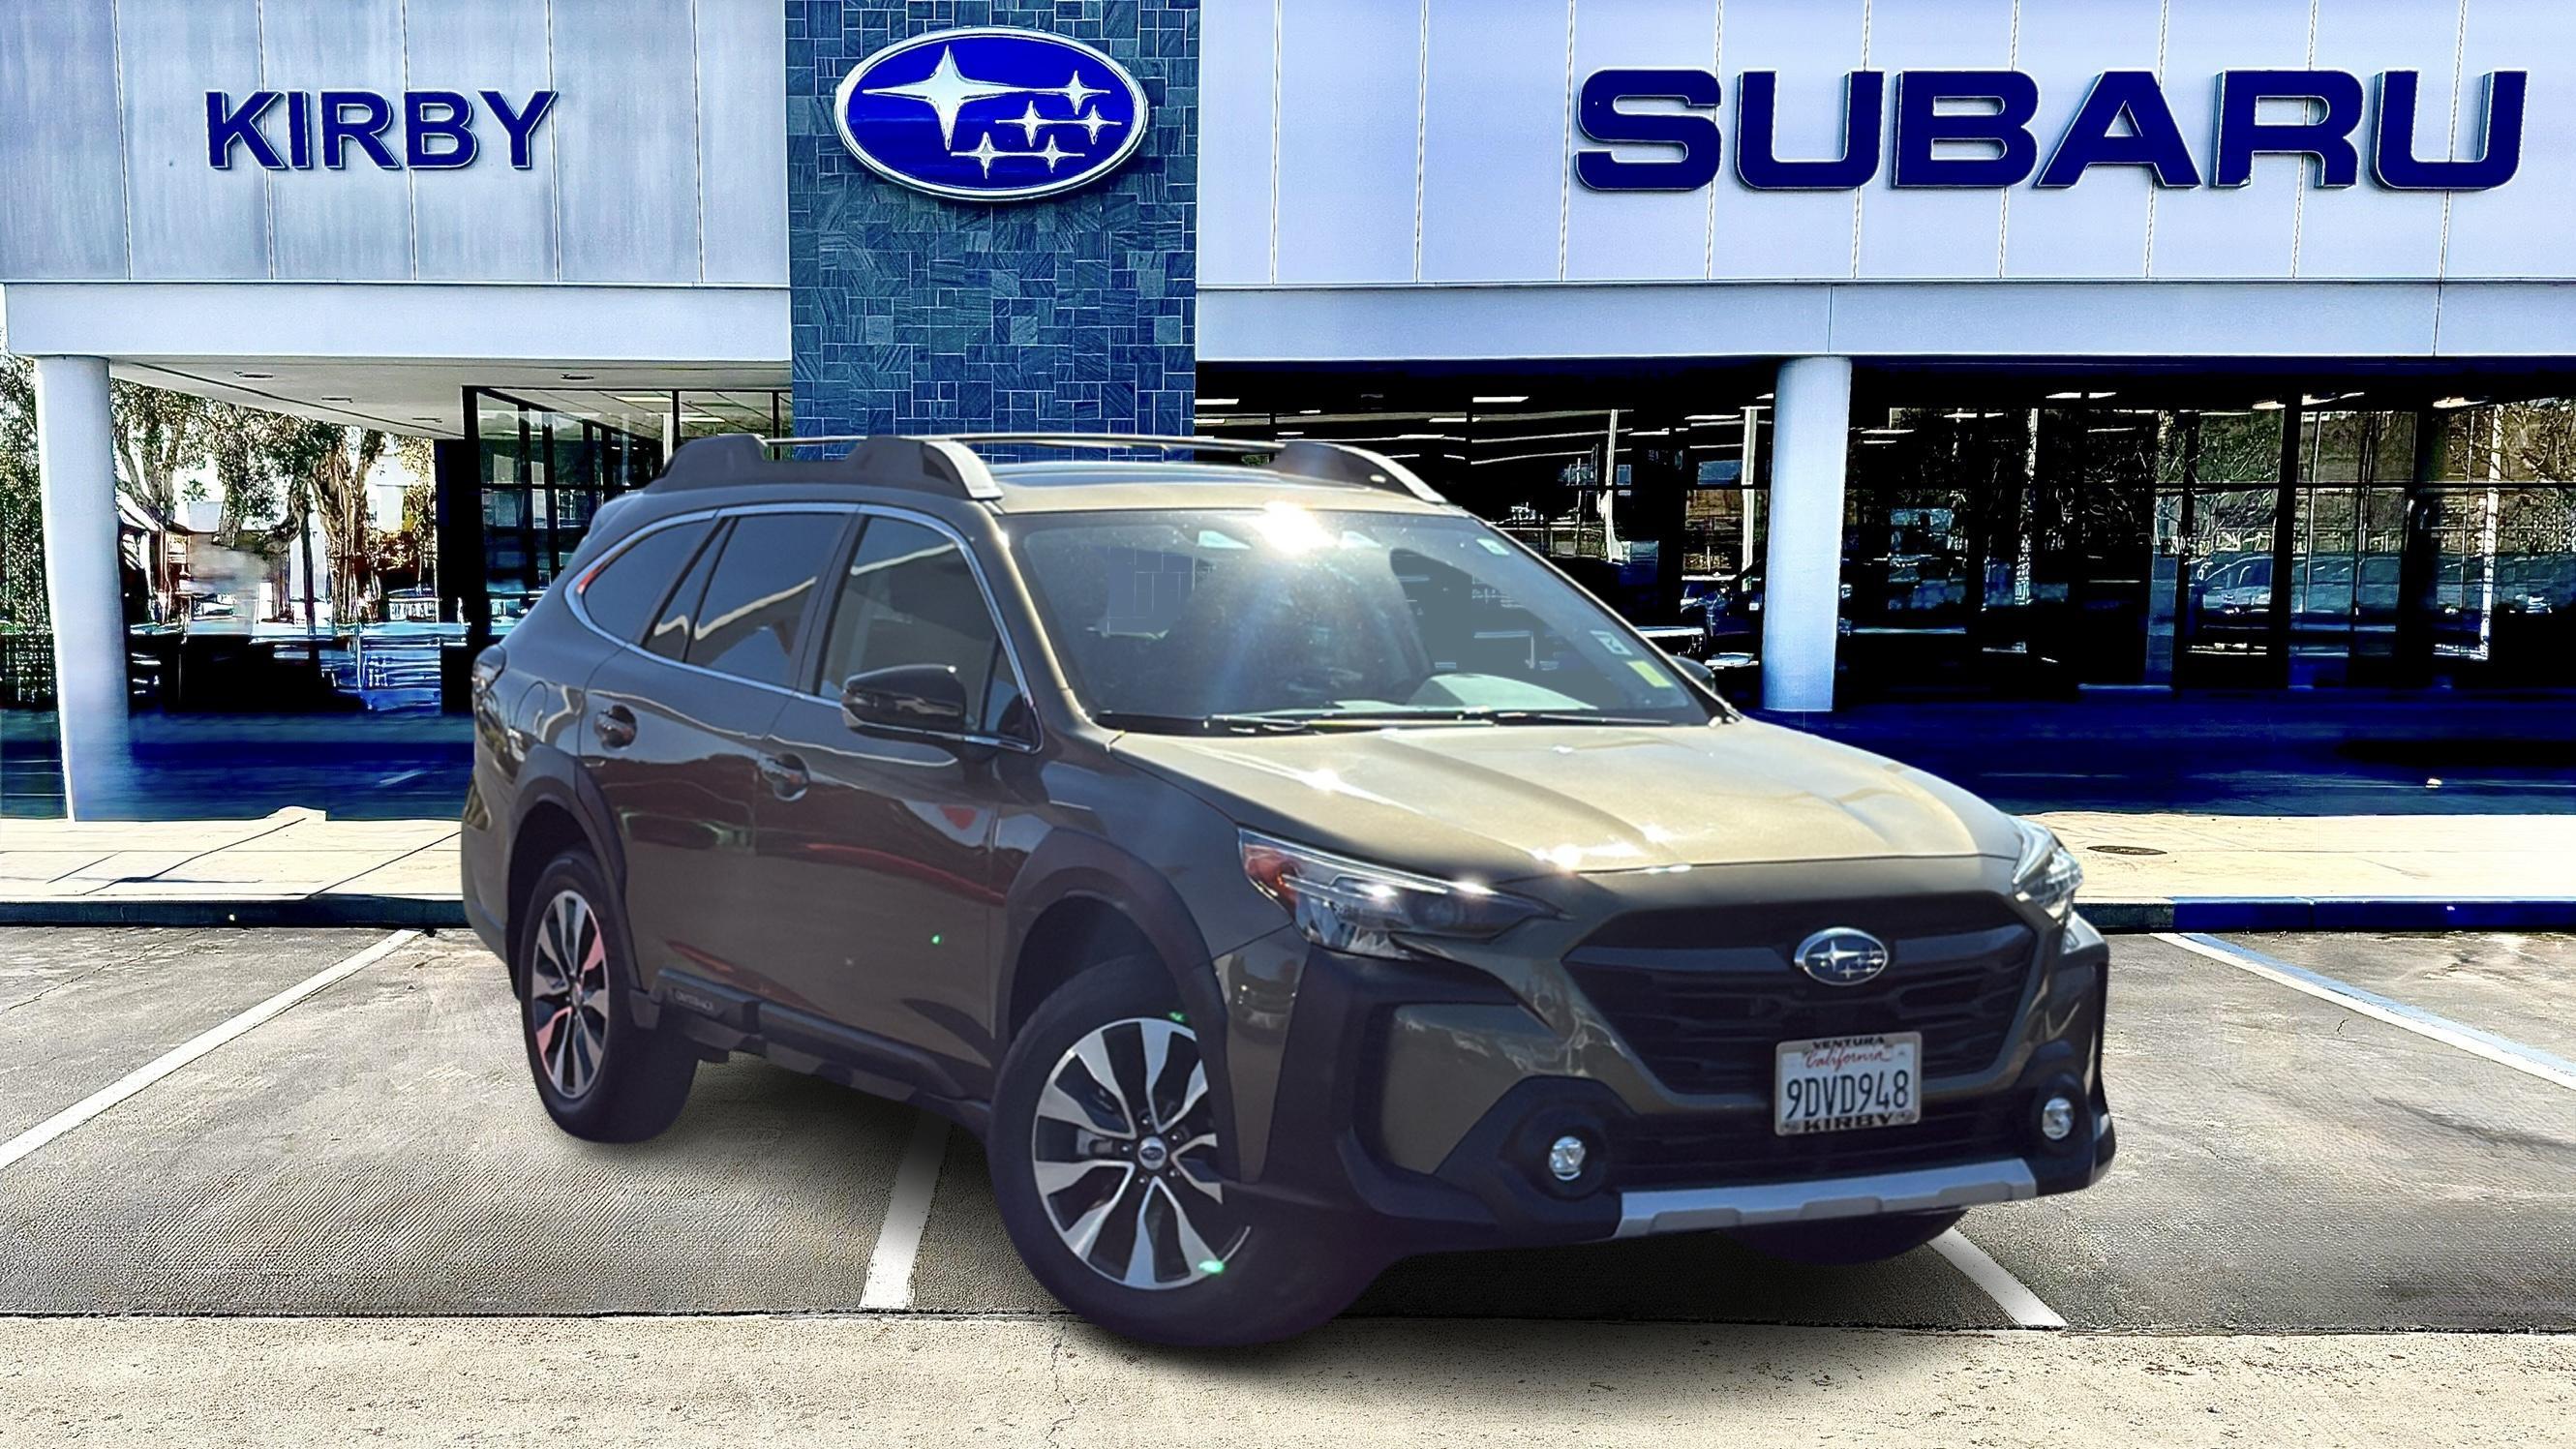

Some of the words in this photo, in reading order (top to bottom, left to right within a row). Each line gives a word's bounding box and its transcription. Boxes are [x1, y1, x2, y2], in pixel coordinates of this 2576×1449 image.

[204, 90, 559, 169] KIRBY
[1575, 68, 2528, 192] SUBARU
[1804, 1047, 1892, 1071] California
[1811, 1036, 1886, 1049] VENTURA
[1786, 1069, 1909, 1120] 9DVD948
[1803, 1112, 1894, 1132] KIRBY
